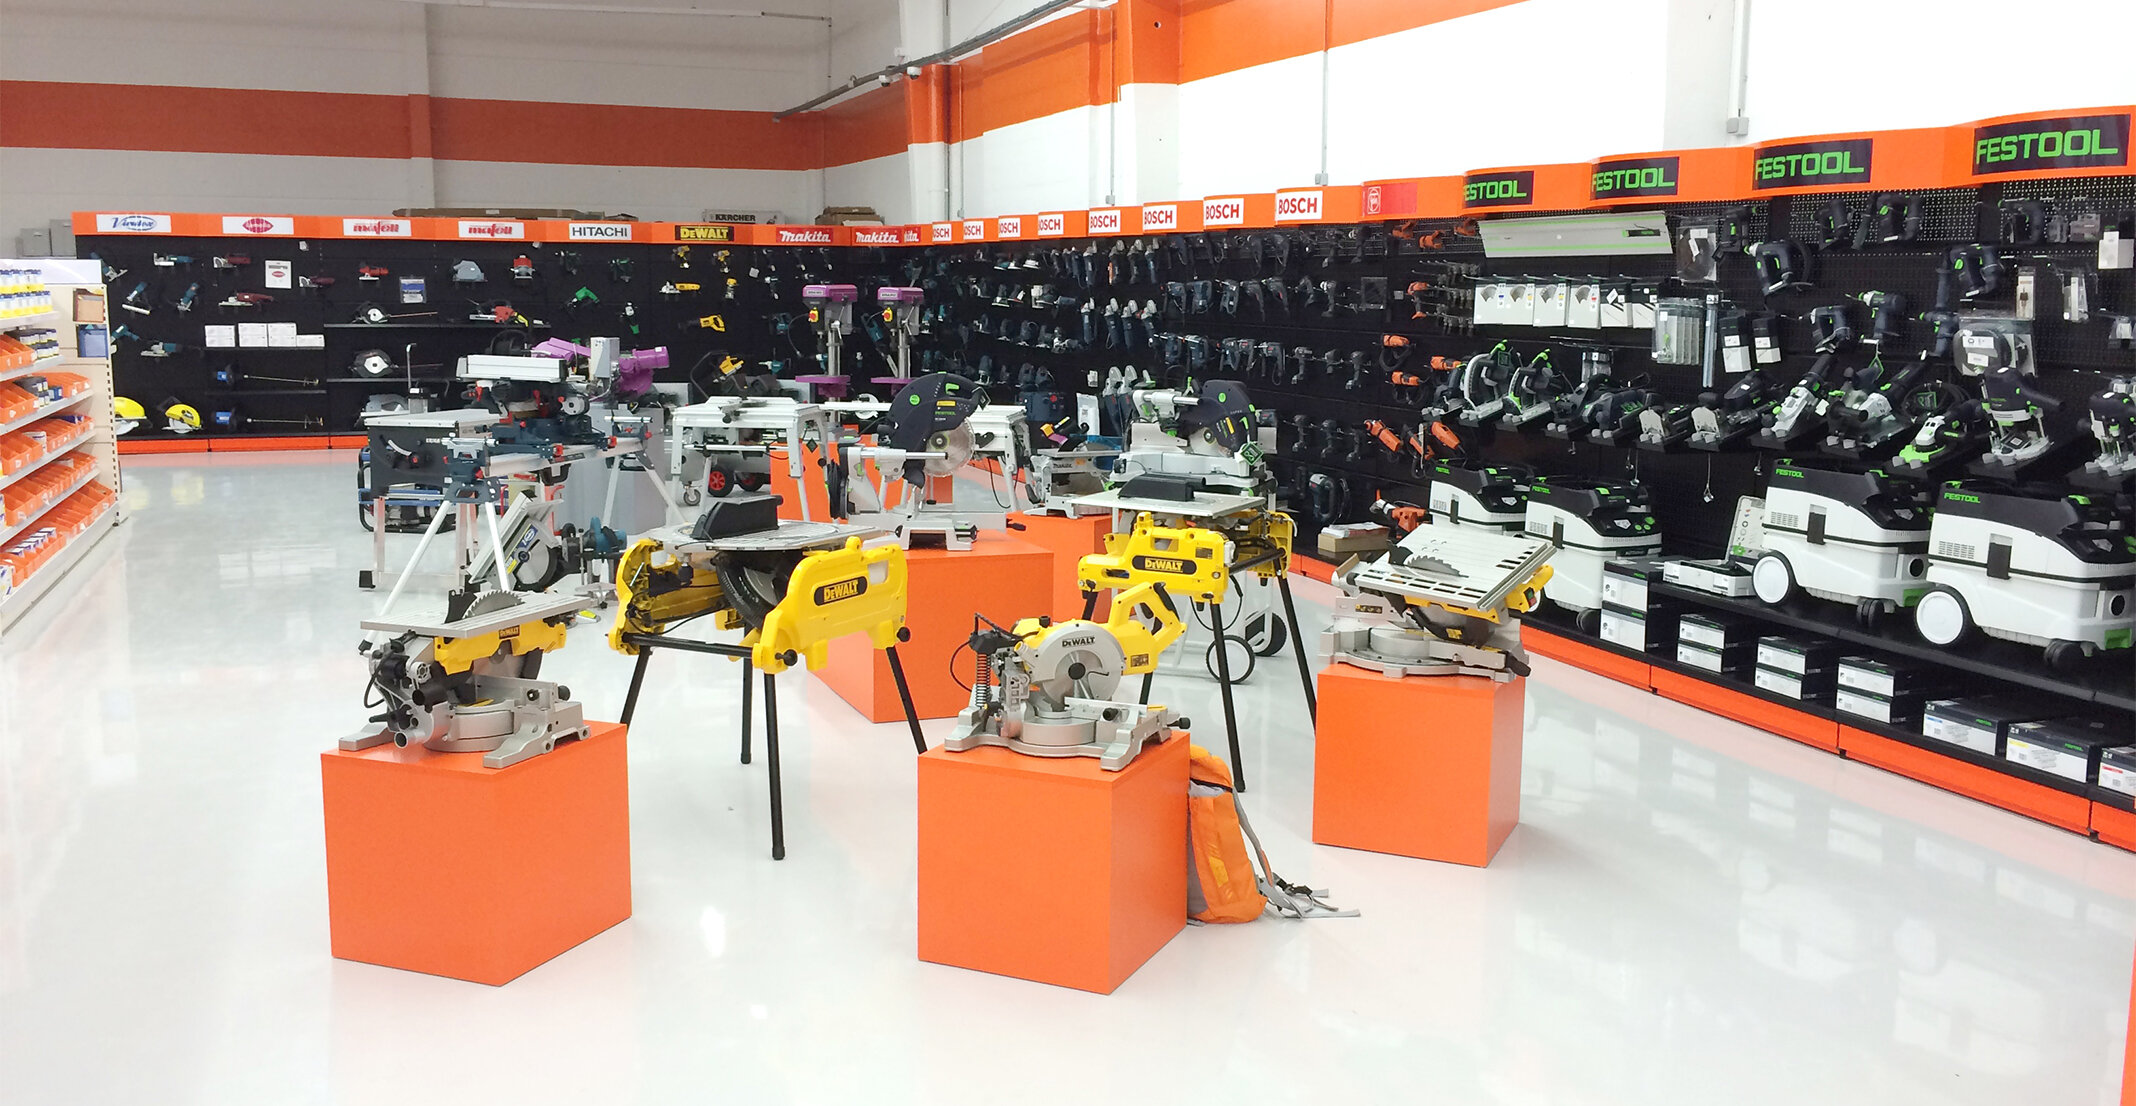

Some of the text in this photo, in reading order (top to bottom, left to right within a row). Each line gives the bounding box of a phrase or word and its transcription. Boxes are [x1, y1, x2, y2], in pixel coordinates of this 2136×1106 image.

[1976, 129, 2119, 165] FESTOOL
[1755, 151, 1864, 181] FESTOOL
[1206, 204, 1239, 220] BOSCH
[1278, 197, 1317, 214] BOSCH
[1090, 215, 1117, 228] BOSCH
[1144, 210, 1173, 225] BOSCH
[572, 227, 628, 237] HITACHI
[1944, 492, 1981, 504] FESTOOL
